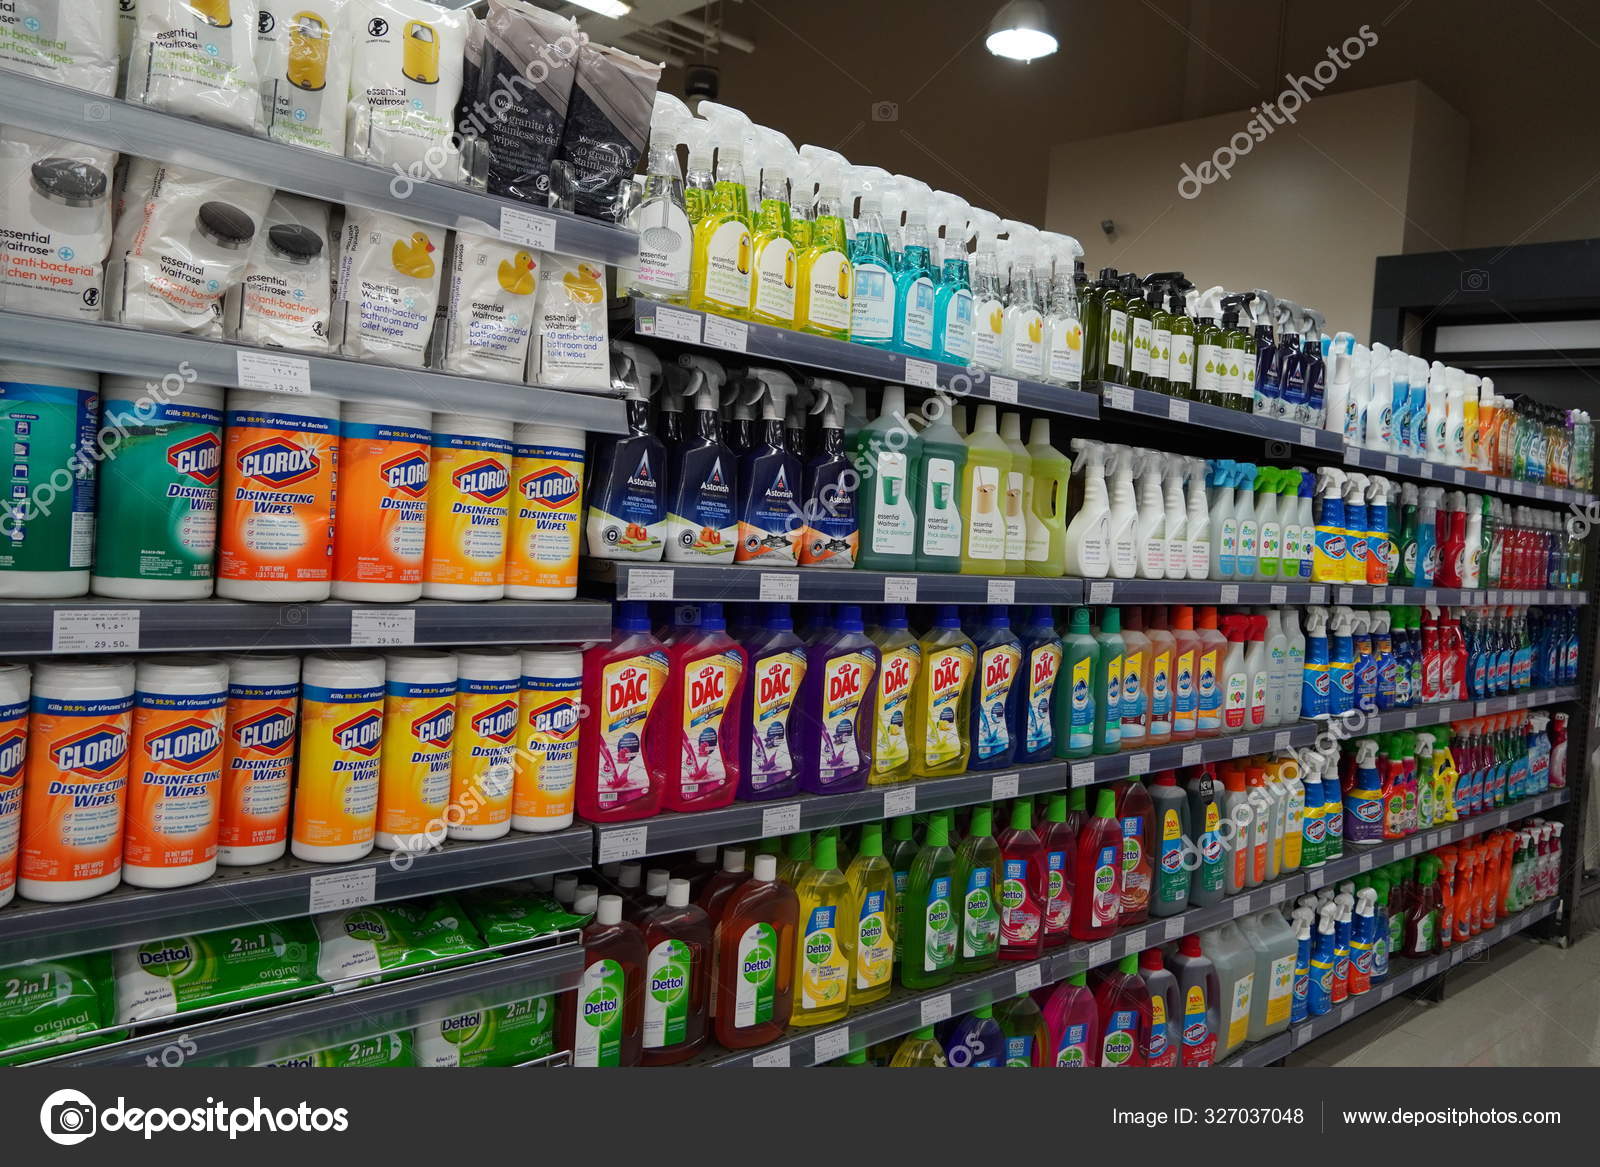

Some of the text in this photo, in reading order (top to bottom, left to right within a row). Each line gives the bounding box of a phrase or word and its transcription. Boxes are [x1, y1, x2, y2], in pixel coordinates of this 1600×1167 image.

[157, 28, 198, 40] essential
[367, 97, 405, 106] Waitrose
[493, 123, 559, 146] stainless steel
[493, 134, 520, 149] wipes
[640, 251, 667, 261] essential
[640, 258, 667, 268] Waitrose
[12, 255, 94, 277] anti-bacterial
[161, 255, 205, 276] essential
[40, 271, 74, 287] wipes
[160, 264, 201, 286] Waitrose
[247, 274, 287, 288] essential
[361, 280, 399, 296] essential
[258, 294, 319, 316] anti-bacterial
[360, 301, 428, 323] 40 anti-bacterial
[472, 302, 504, 313] essential
[282, 309, 305, 323] wipes
[360, 312, 420, 330] bathroom and
[471, 311, 503, 322] Waitrose
[545, 313, 576, 324] essential
[384, 325, 405, 338] wipes
[469, 320, 480, 330] 40
[545, 322, 576, 331] Waitrose
[507, 334, 521, 344] and
[557, 331, 604, 343] anti-bacterial
[490, 341, 508, 352] wipes
[583, 340, 598, 350] and
[566, 351, 587, 360] wipes
[181, 410, 200, 420] 99.9%
[246, 416, 265, 425] 99.9%
[242, 447, 312, 478] CLOROX
[459, 468, 509, 494] CLOROX
[526, 475, 577, 500] CLOROX
[627, 476, 657, 489] Astonish
[700, 482, 729, 493] Astonish
[236, 487, 315, 504] DISINFECTING
[765, 488, 793, 498] Astonish
[829, 496, 851, 504] Astonish
[252, 502, 294, 515] WIPES
[519, 508, 578, 522] DISINFECTING
[471, 514, 500, 527] WIPES
[536, 519, 566, 531] WIPES
[884, 661, 909, 694] DAC
[934, 660, 960, 692] DAC
[986, 657, 1010, 687] DAC
[1034, 655, 1053, 685] DAC
[691, 671, 724, 710] DAC
[760, 670, 791, 703] DAC
[830, 667, 860, 699] DAC
[609, 673, 648, 713] DAC
[63, 704, 86, 713] 99.9%
[58, 731, 128, 771] CLOROX
[150, 727, 222, 763] CLOROX
[546, 750, 573, 762] WIPES
[143, 770, 221, 786] DISINFECTING
[252, 767, 287, 782] WIPES
[164, 783, 207, 798] WIPES
[73, 792, 117, 809] WIPES
[1121, 850, 1139, 861] ettol
[1095, 875, 1114, 885] Dettol
[967, 900, 989, 911] Dettol
[928, 911, 951, 923] Dettol
[344, 920, 386, 936] Dettol
[861, 926, 882, 938] Dettol
[231, 934, 266, 952] 2 in 1
[806, 944, 832, 954] Dettol
[139, 946, 191, 965] Dettol
[744, 958, 772, 974] Dettol
[4, 972, 50, 999] 2 in 1
[652, 976, 684, 992] Dettol
[507, 999, 533, 1018] 2 in 1
[584, 999, 617, 1015] Dettol
[33, 1010, 89, 1034] original
[442, 1011, 481, 1032] Dettol
[350, 1038, 384, 1059] 2 in 1
[1105, 1043, 1133, 1056] Dettol
